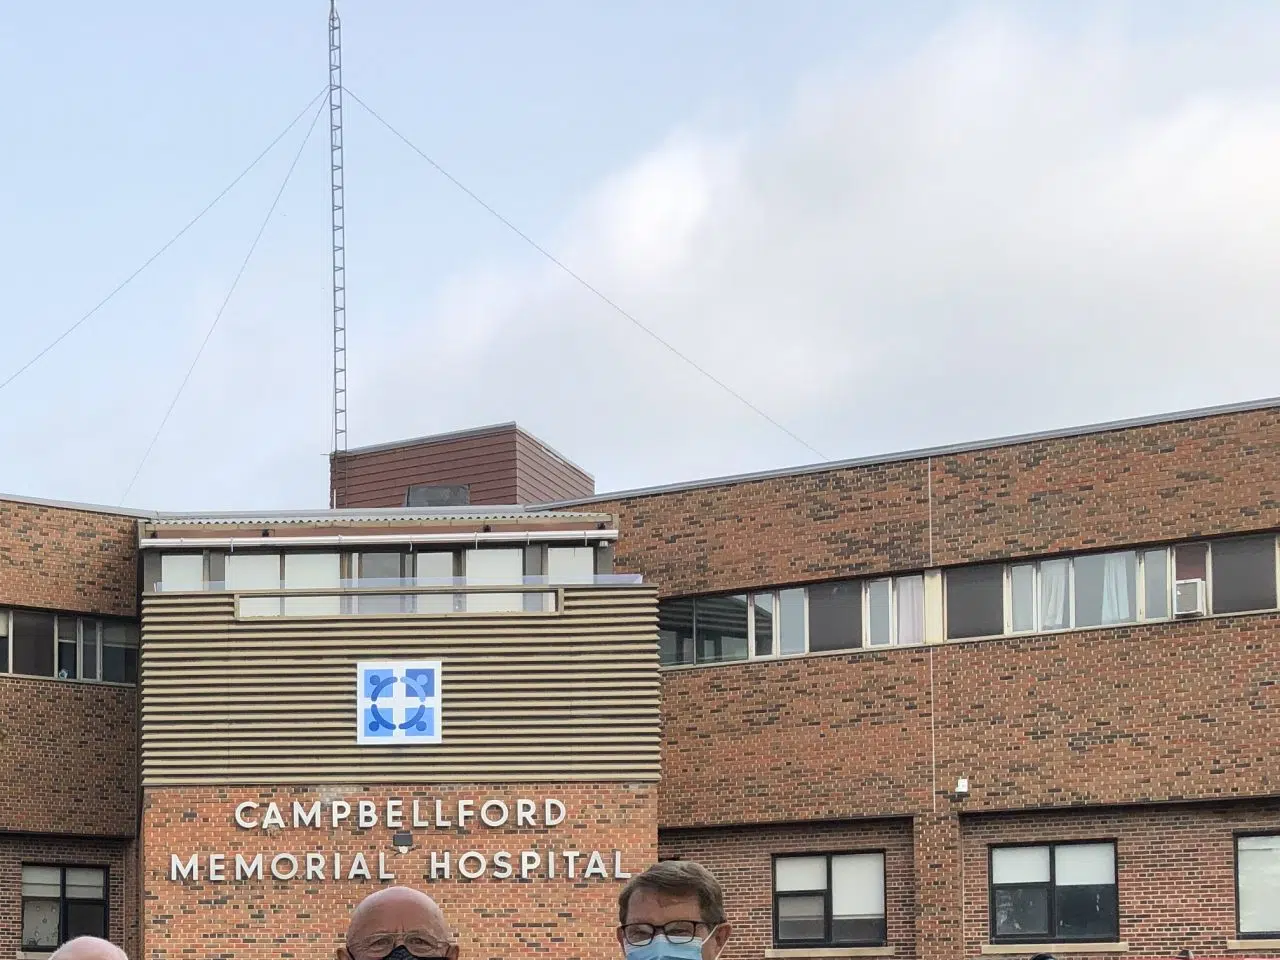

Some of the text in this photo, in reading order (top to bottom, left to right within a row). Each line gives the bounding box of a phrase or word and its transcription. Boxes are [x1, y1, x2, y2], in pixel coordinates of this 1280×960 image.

[235, 798, 566, 830] CAMPBELLFORD
[170, 850, 631, 881] MEMORIAL HOSPITAL
